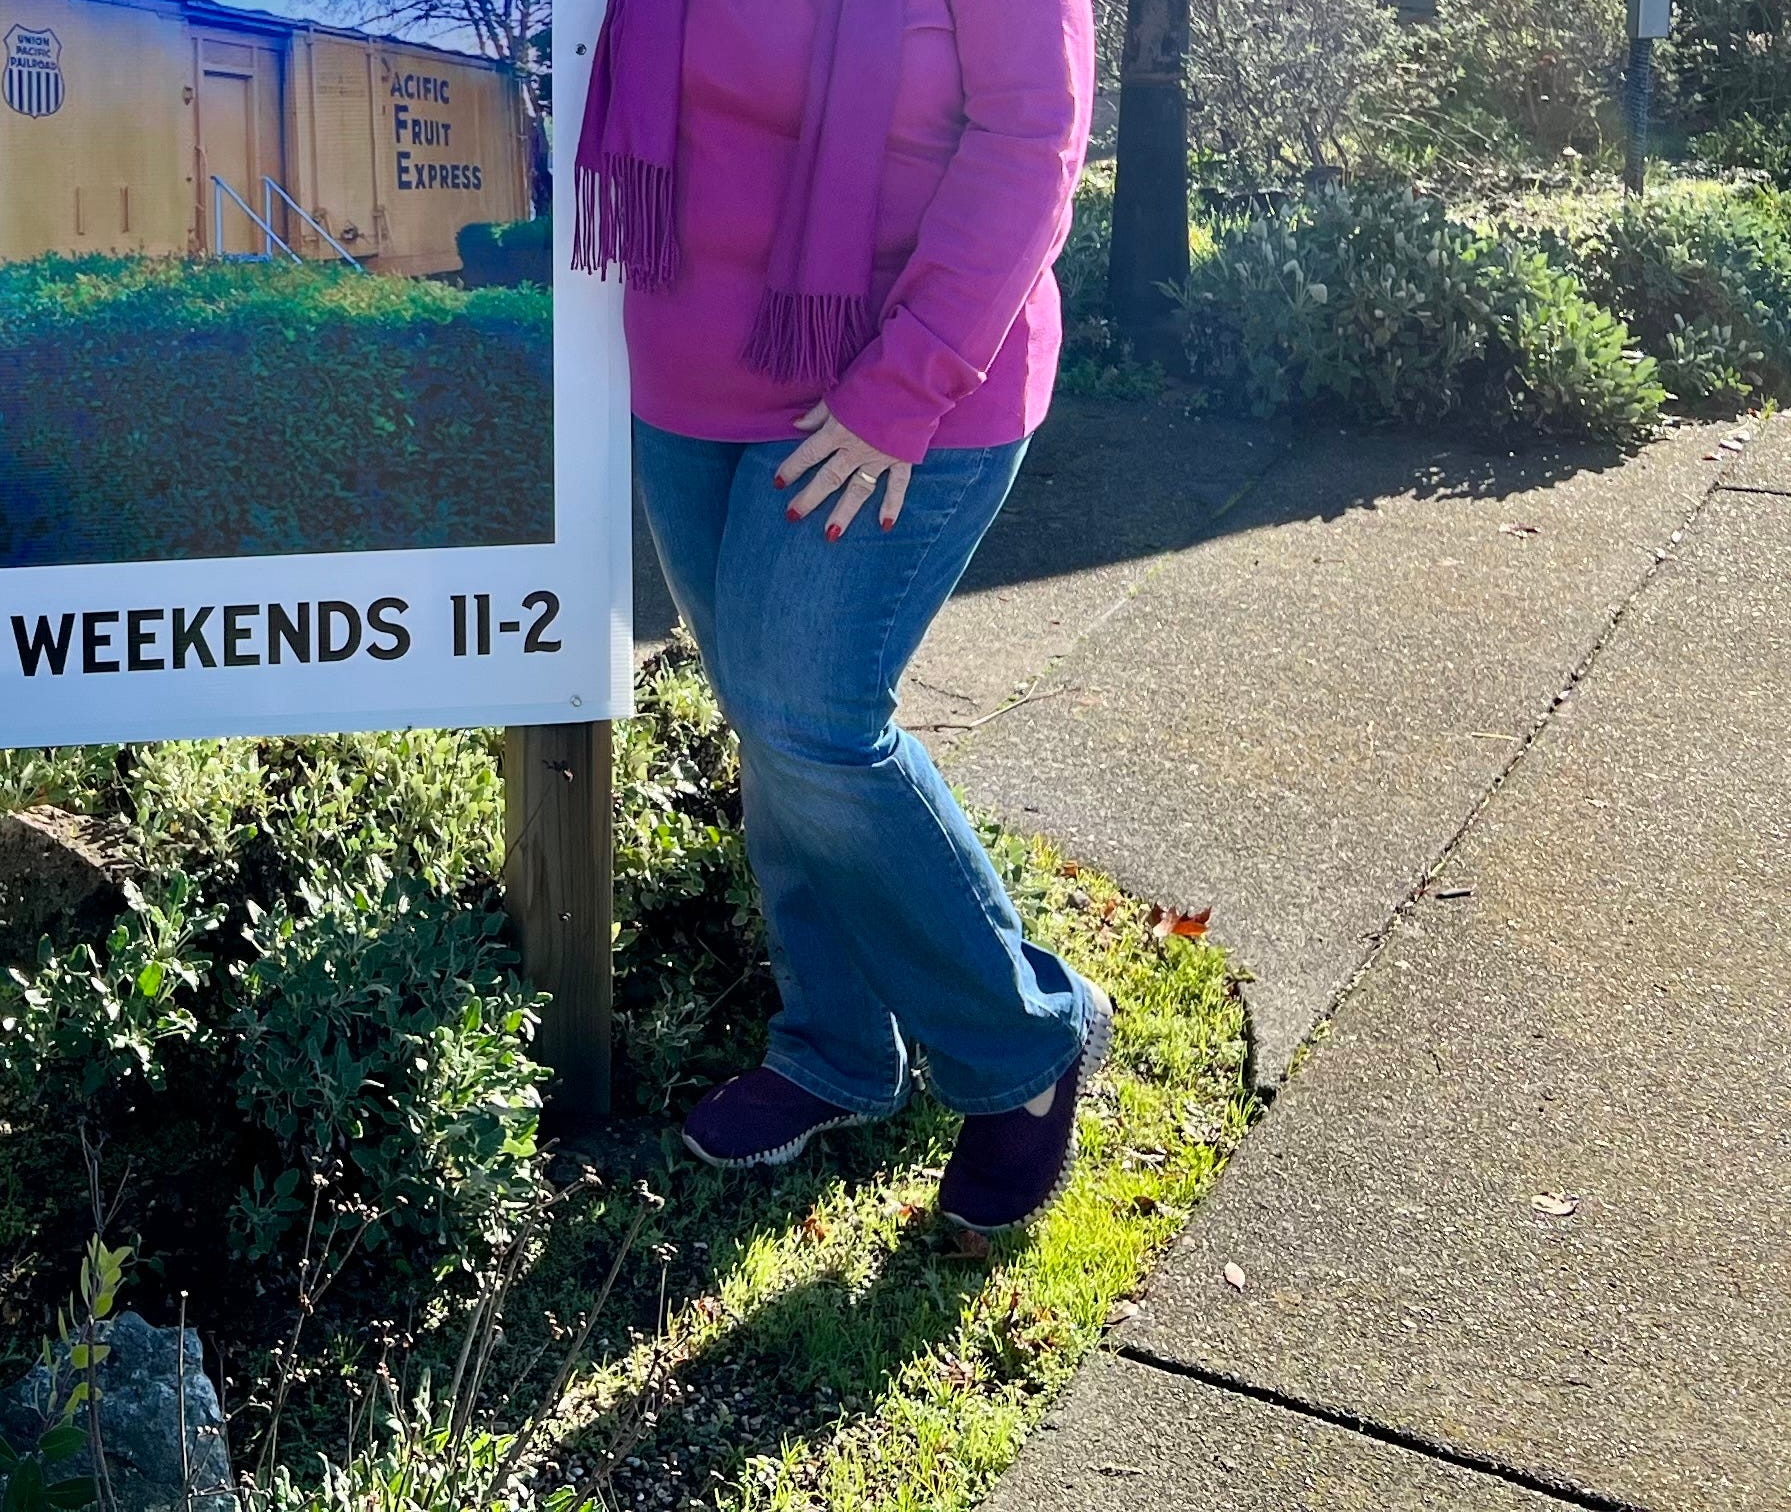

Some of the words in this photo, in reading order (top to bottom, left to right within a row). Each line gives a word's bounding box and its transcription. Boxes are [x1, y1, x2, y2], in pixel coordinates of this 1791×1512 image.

[394, 103, 451, 147] FRUIT
[396, 151, 483, 190] EXPRESS
[10, 597, 411, 677] WEEKENDS
